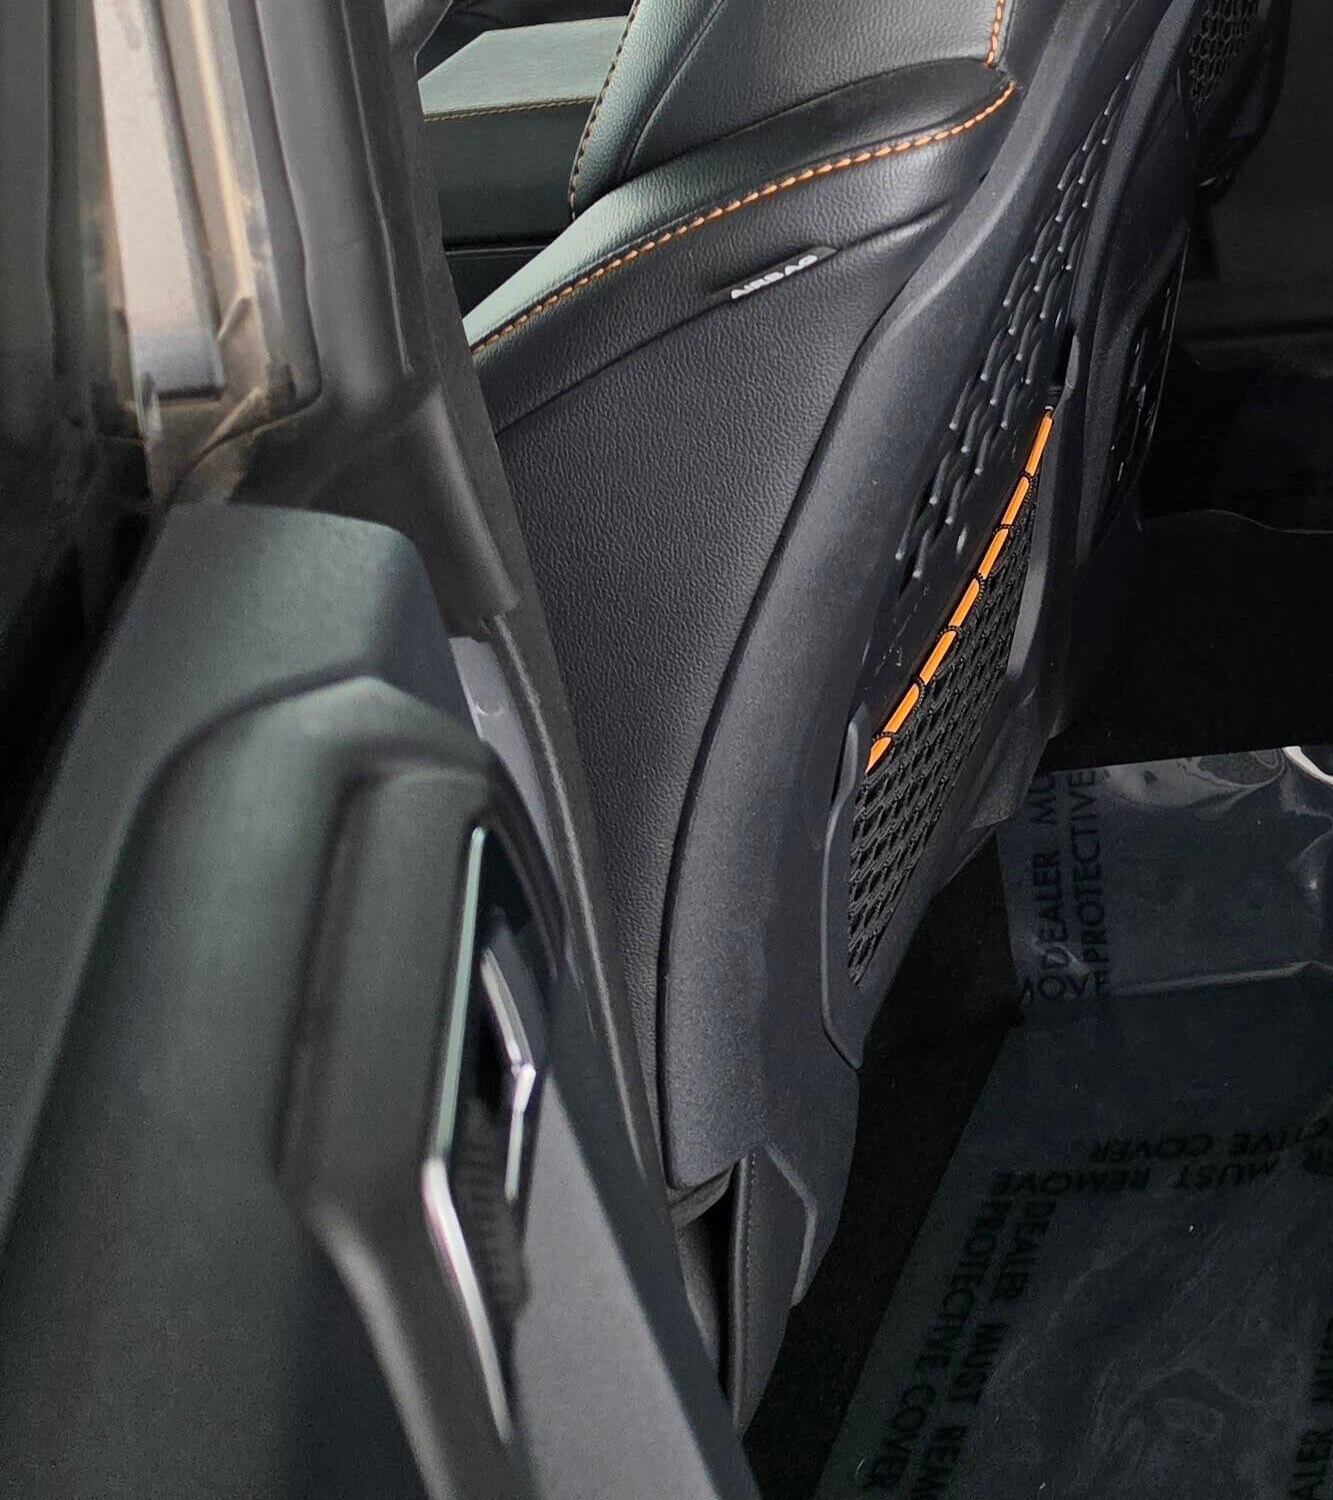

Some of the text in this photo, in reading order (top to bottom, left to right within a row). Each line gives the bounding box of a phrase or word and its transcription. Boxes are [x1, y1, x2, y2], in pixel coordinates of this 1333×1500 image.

[1032, 847, 1070, 969] DEALER
[1068, 768, 1110, 963] PROTECTIVE
[989, 1167, 1151, 1197] REMOVE
[1088, 1132, 1214, 1164] COVER
[1174, 1157, 1282, 1191] MUST
[991, 1200, 1057, 1303] DEALER
[862, 1200, 1014, 1491] PROTECTIVE COVER
[949, 1323, 1011, 1404] MUST
